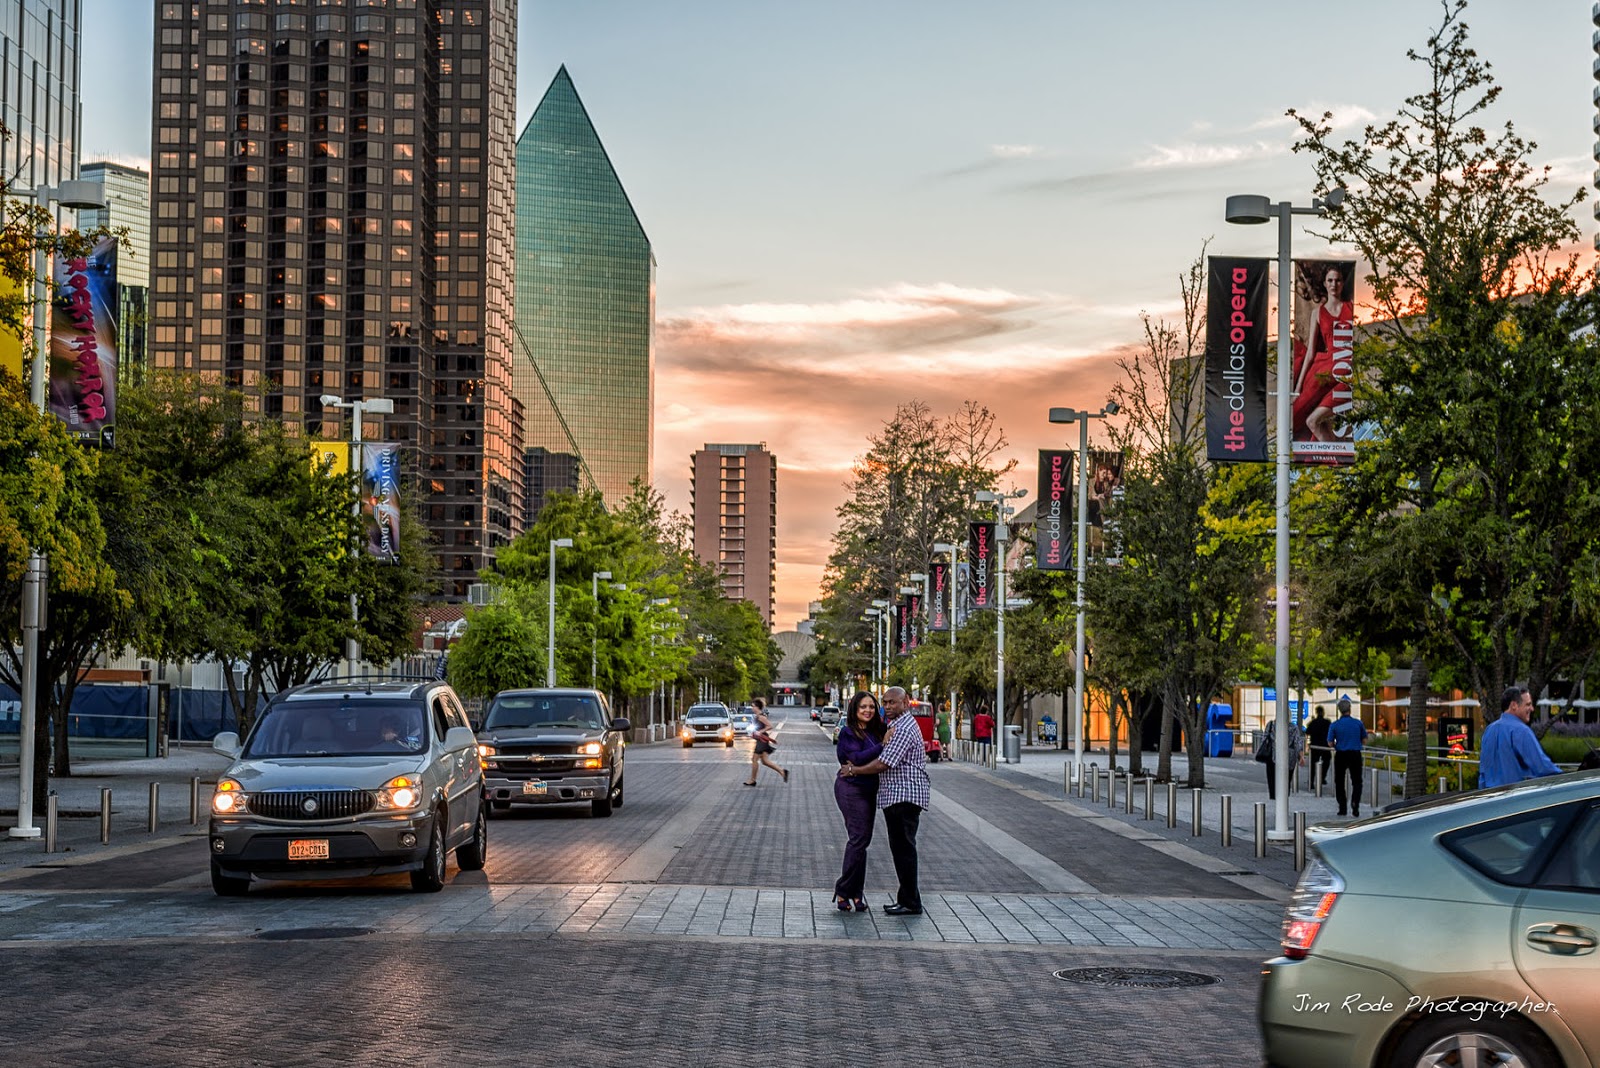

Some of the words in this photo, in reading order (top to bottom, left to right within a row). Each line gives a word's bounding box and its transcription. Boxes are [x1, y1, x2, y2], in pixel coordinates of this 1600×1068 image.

[62, 256, 97, 333] ROCKY
[70, 334, 107, 424] HORROR
[1222, 267, 1254, 452] thedallasopera
[381, 448, 391, 495] DRIVING
[1046, 456, 1065, 565] thedallasopera
[381, 527, 390, 553] DAISY
[976, 526, 990, 606] thedallasopera
[934, 566, 945, 628] thedallasopera
